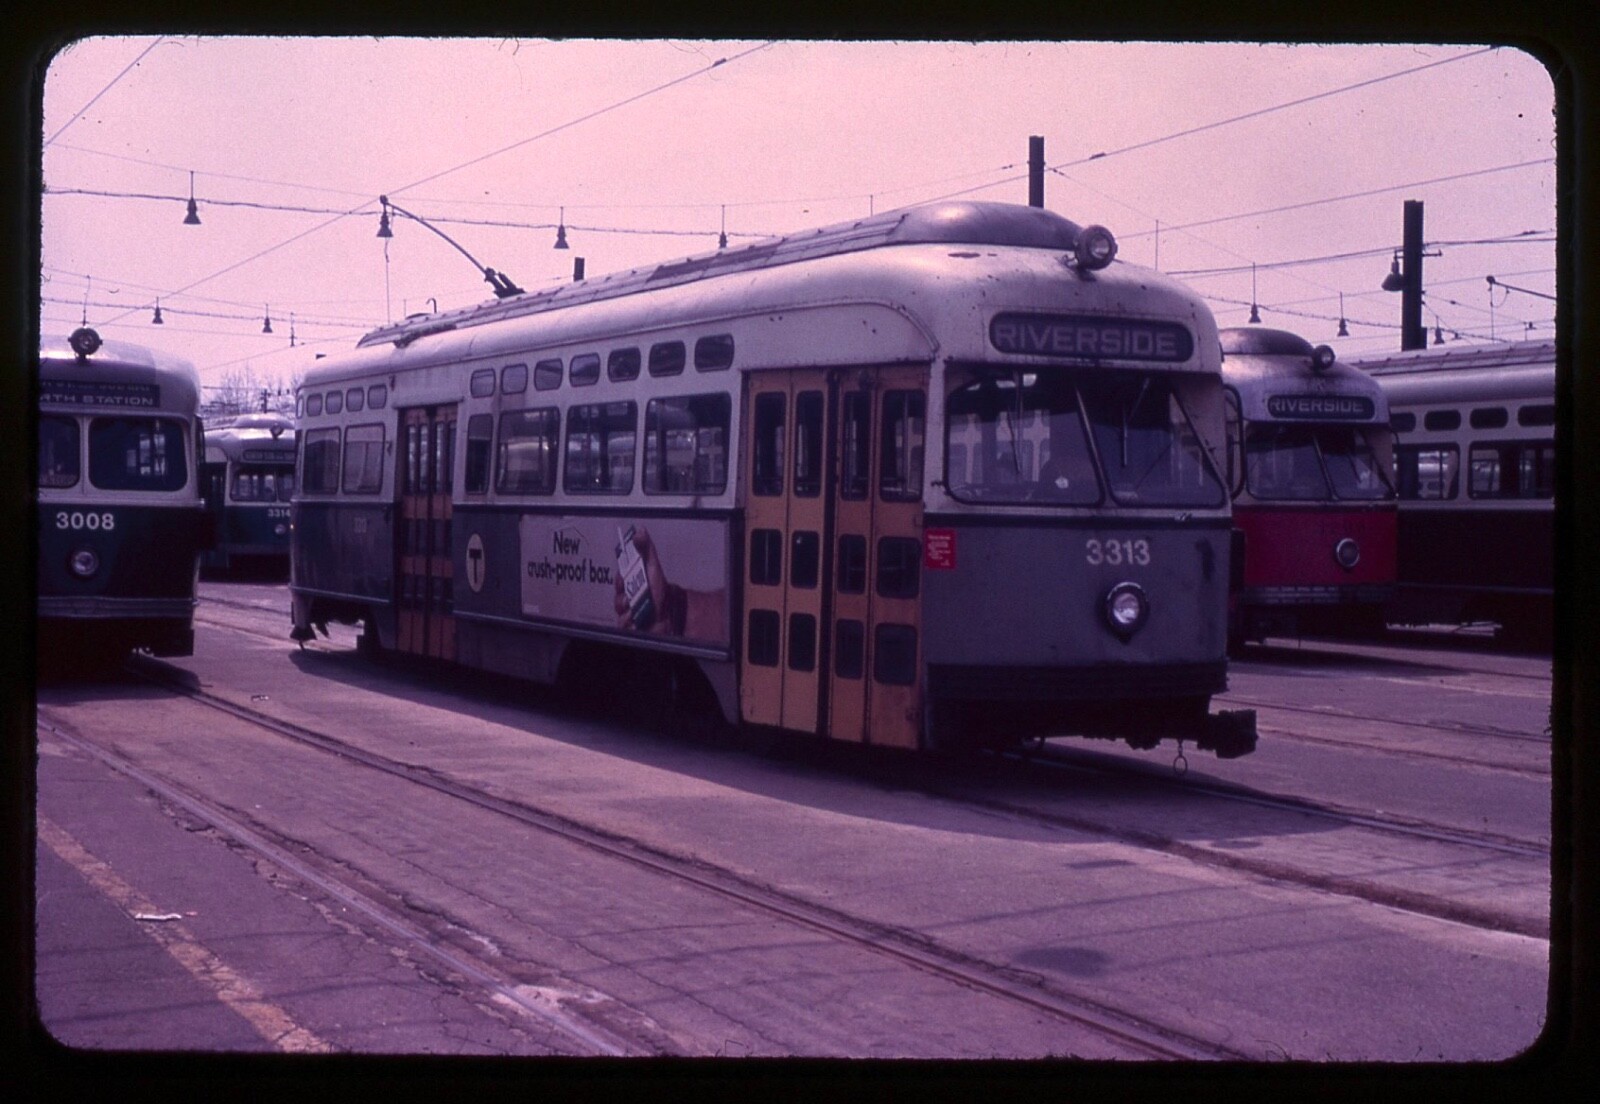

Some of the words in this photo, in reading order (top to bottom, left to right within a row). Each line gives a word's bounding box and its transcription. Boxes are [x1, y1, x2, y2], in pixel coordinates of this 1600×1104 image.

[994, 324, 1178, 357] RIVERSIDE
[82, 394, 153, 406] STATION
[1270, 398, 1364, 413] RIVERSIDE
[55, 511, 115, 530] 3008
[267, 508, 291, 518] 3314
[553, 530, 581, 555] New
[1085, 538, 1151, 566] 3313
[468, 547, 483, 585] T
[527, 556, 587, 585] crush-proof
[589, 558, 614, 585] box.
